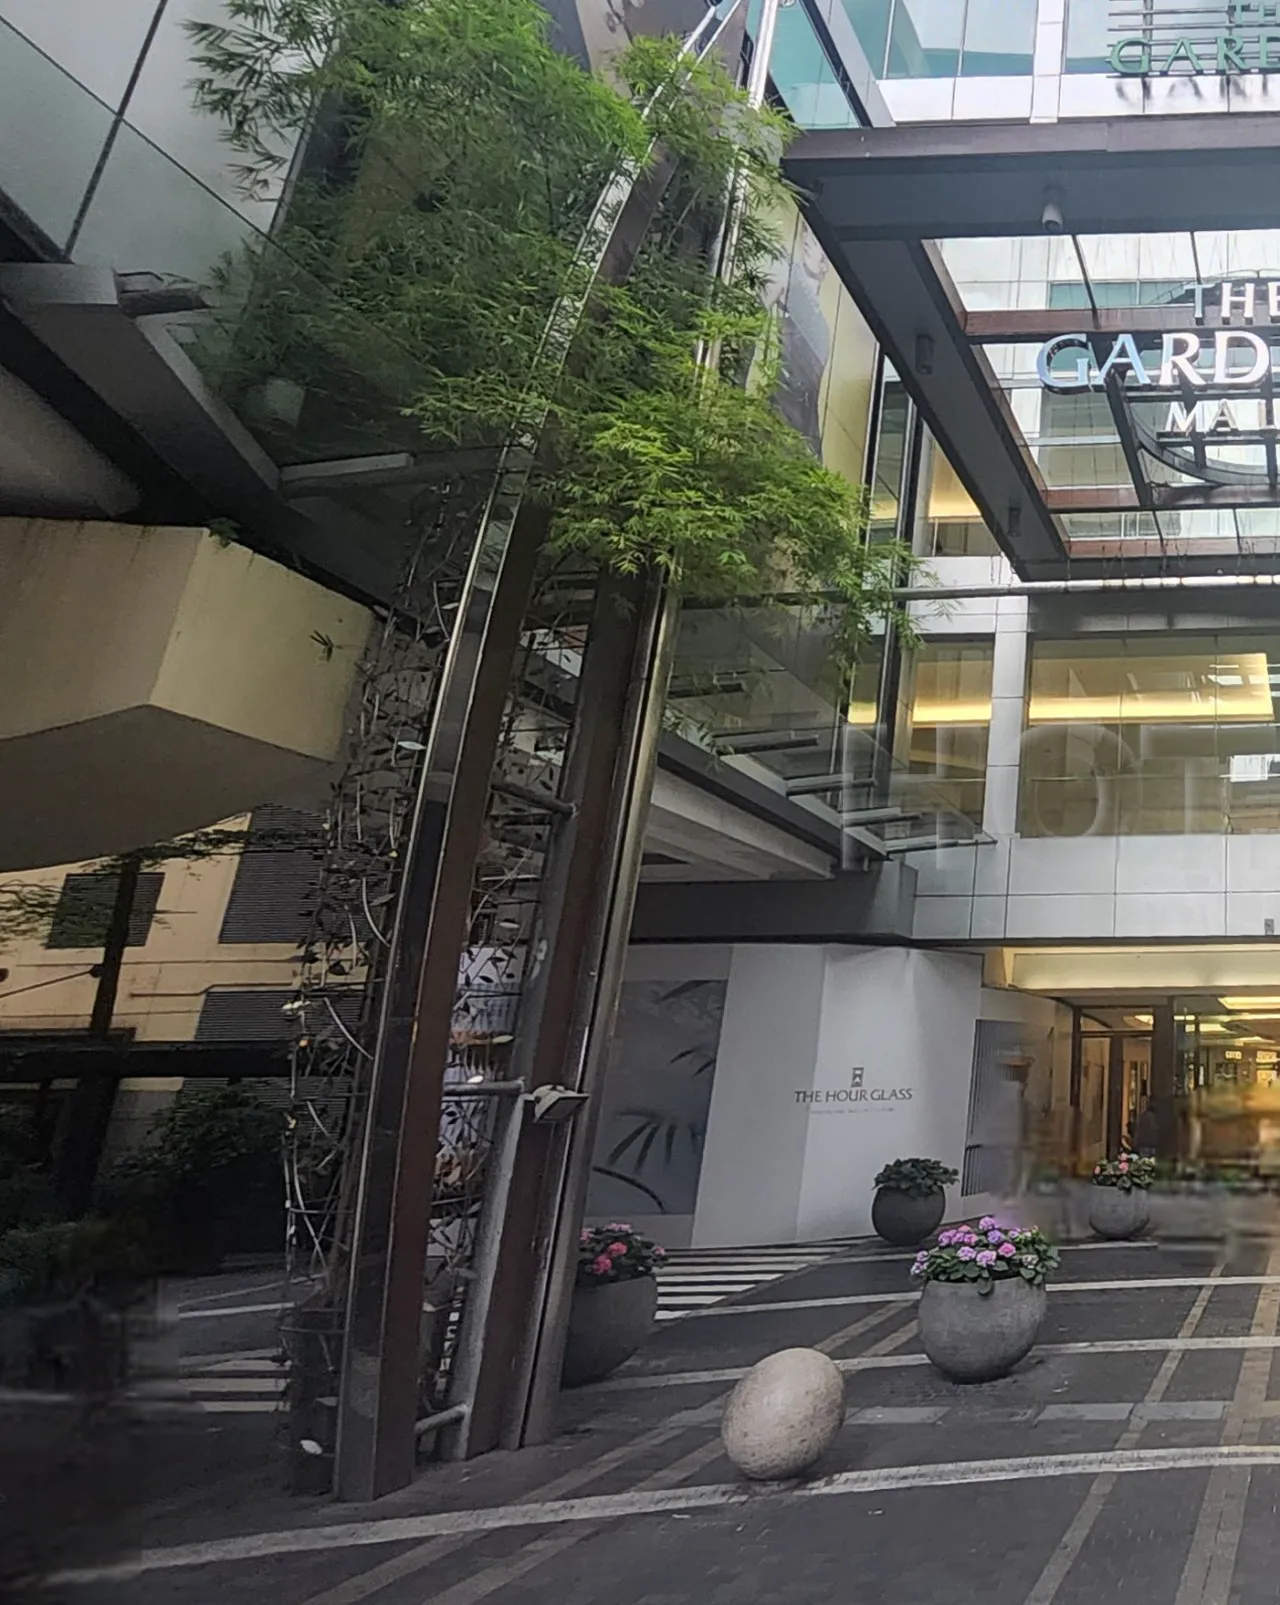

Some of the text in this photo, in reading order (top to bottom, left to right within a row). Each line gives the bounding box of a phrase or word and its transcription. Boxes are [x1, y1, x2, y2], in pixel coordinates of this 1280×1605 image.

[793, 1088, 913, 1103] THE HOUR GLASS
